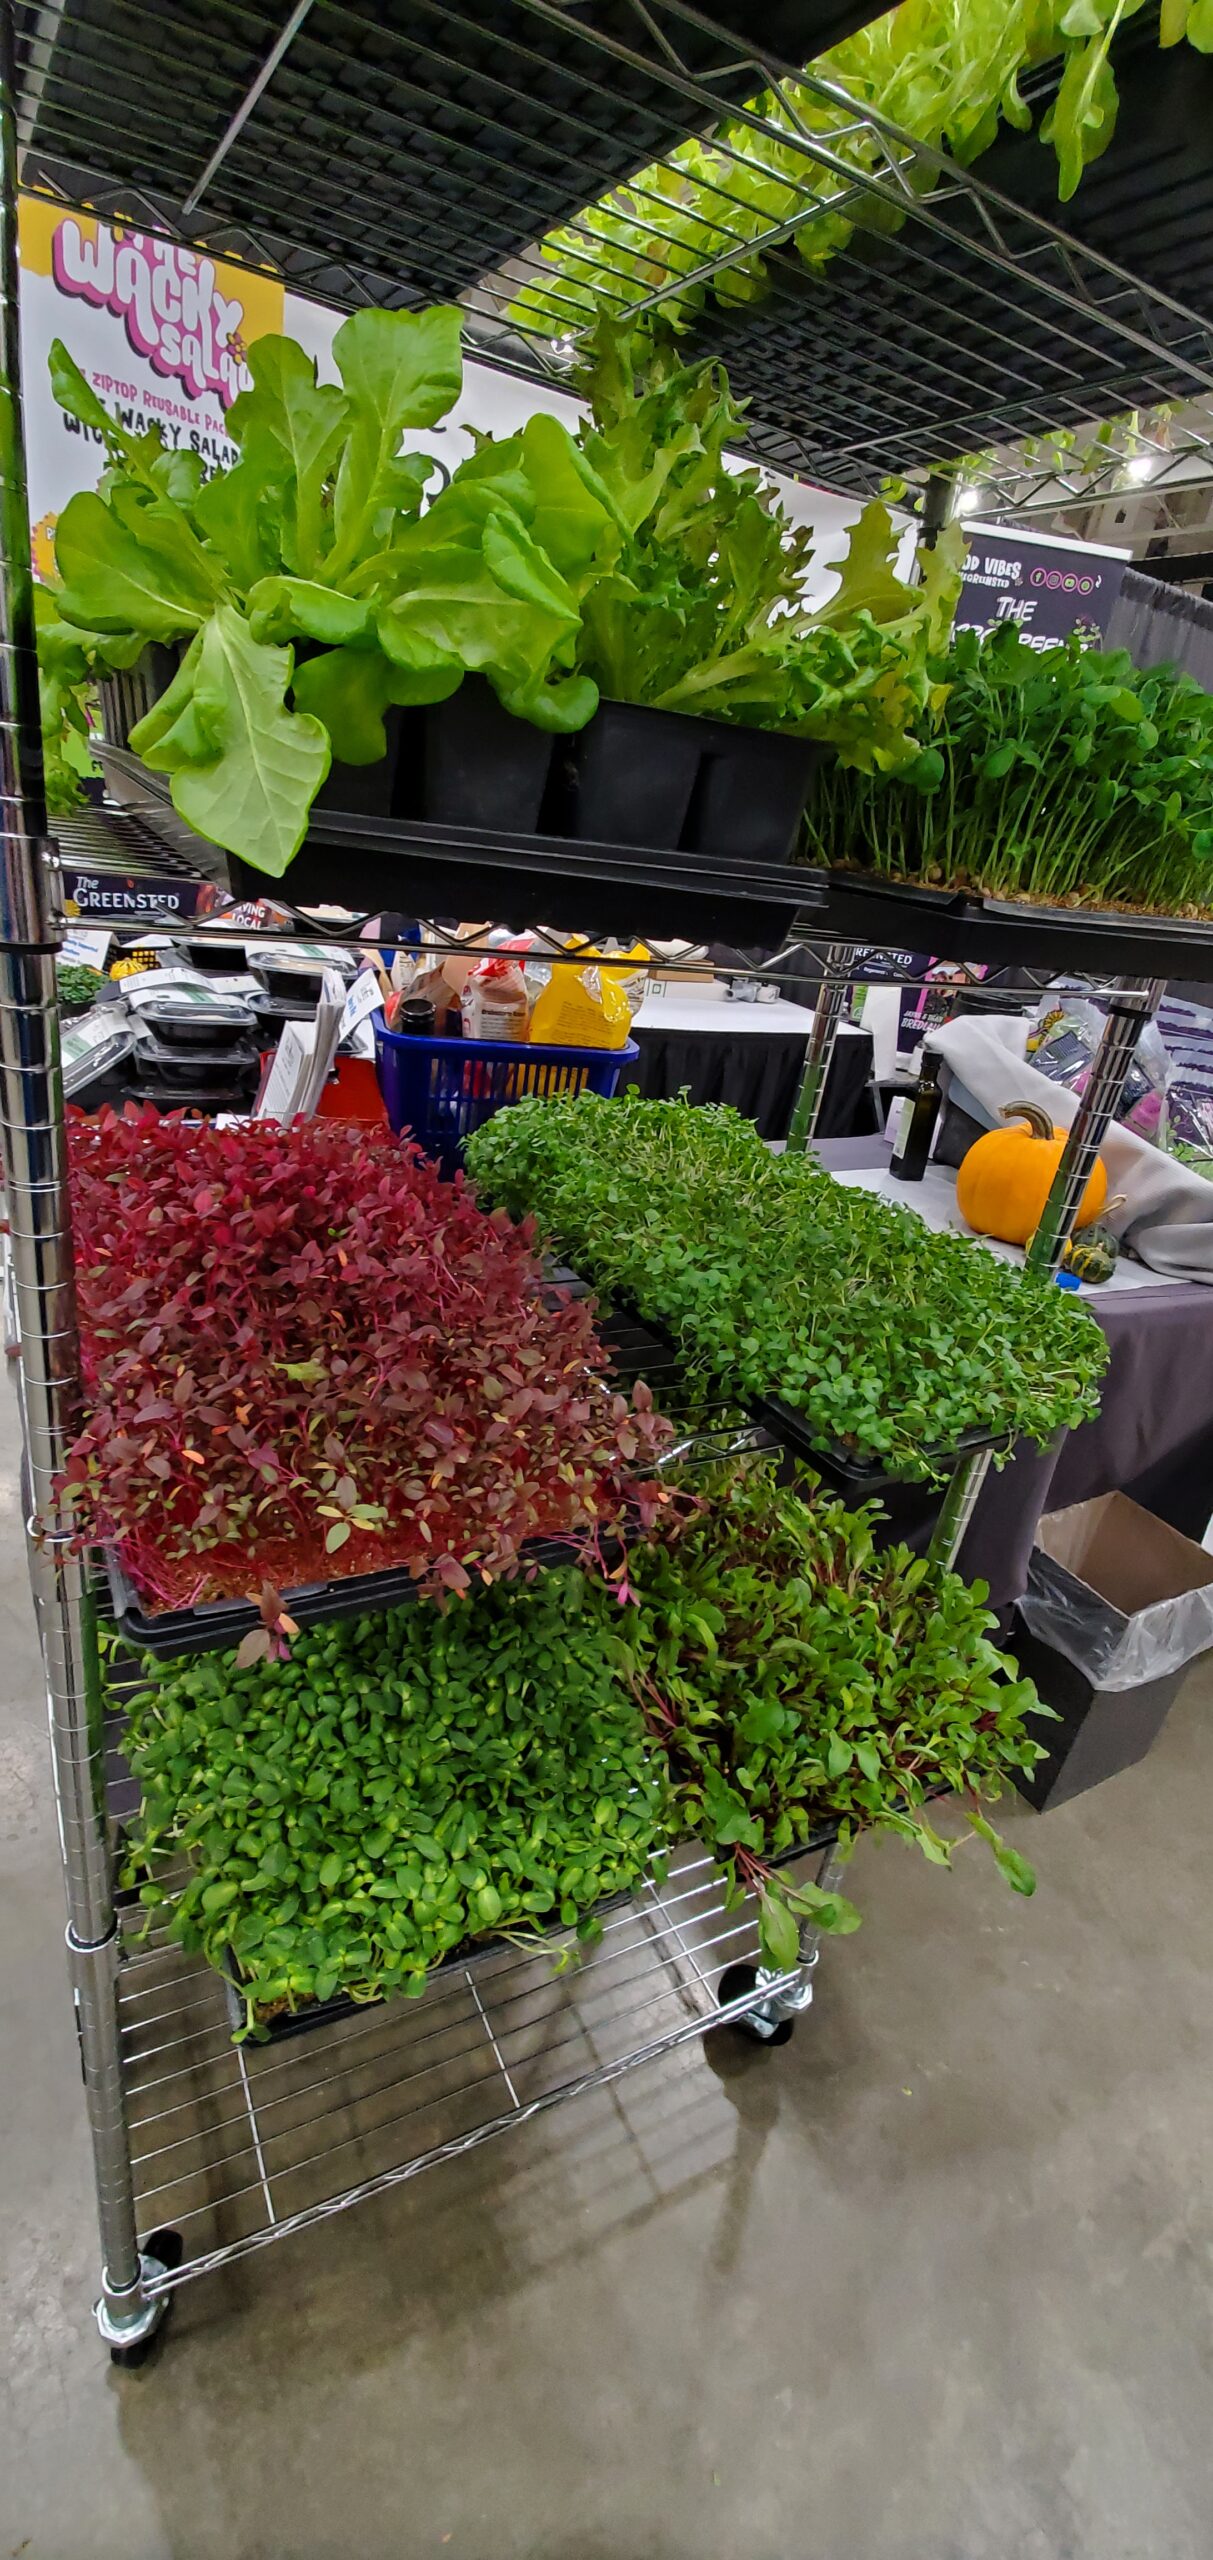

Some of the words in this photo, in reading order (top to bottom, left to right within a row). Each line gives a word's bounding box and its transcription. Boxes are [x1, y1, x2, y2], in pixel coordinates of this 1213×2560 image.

[61, 219, 244, 349] WACKY
[159, 322, 255, 401] SALAD
[92, 371, 138, 403] ZIPTOP
[142, 389, 200, 426] REUSABLE
[189, 430, 241, 466] SALAD
[985, 557, 1022, 580] VIBES
[996, 596, 1037, 621] THE
[76, 876, 99, 889] The
[73, 887, 179, 909] GREENSTED
[231, 912, 262, 931] LOCAL
